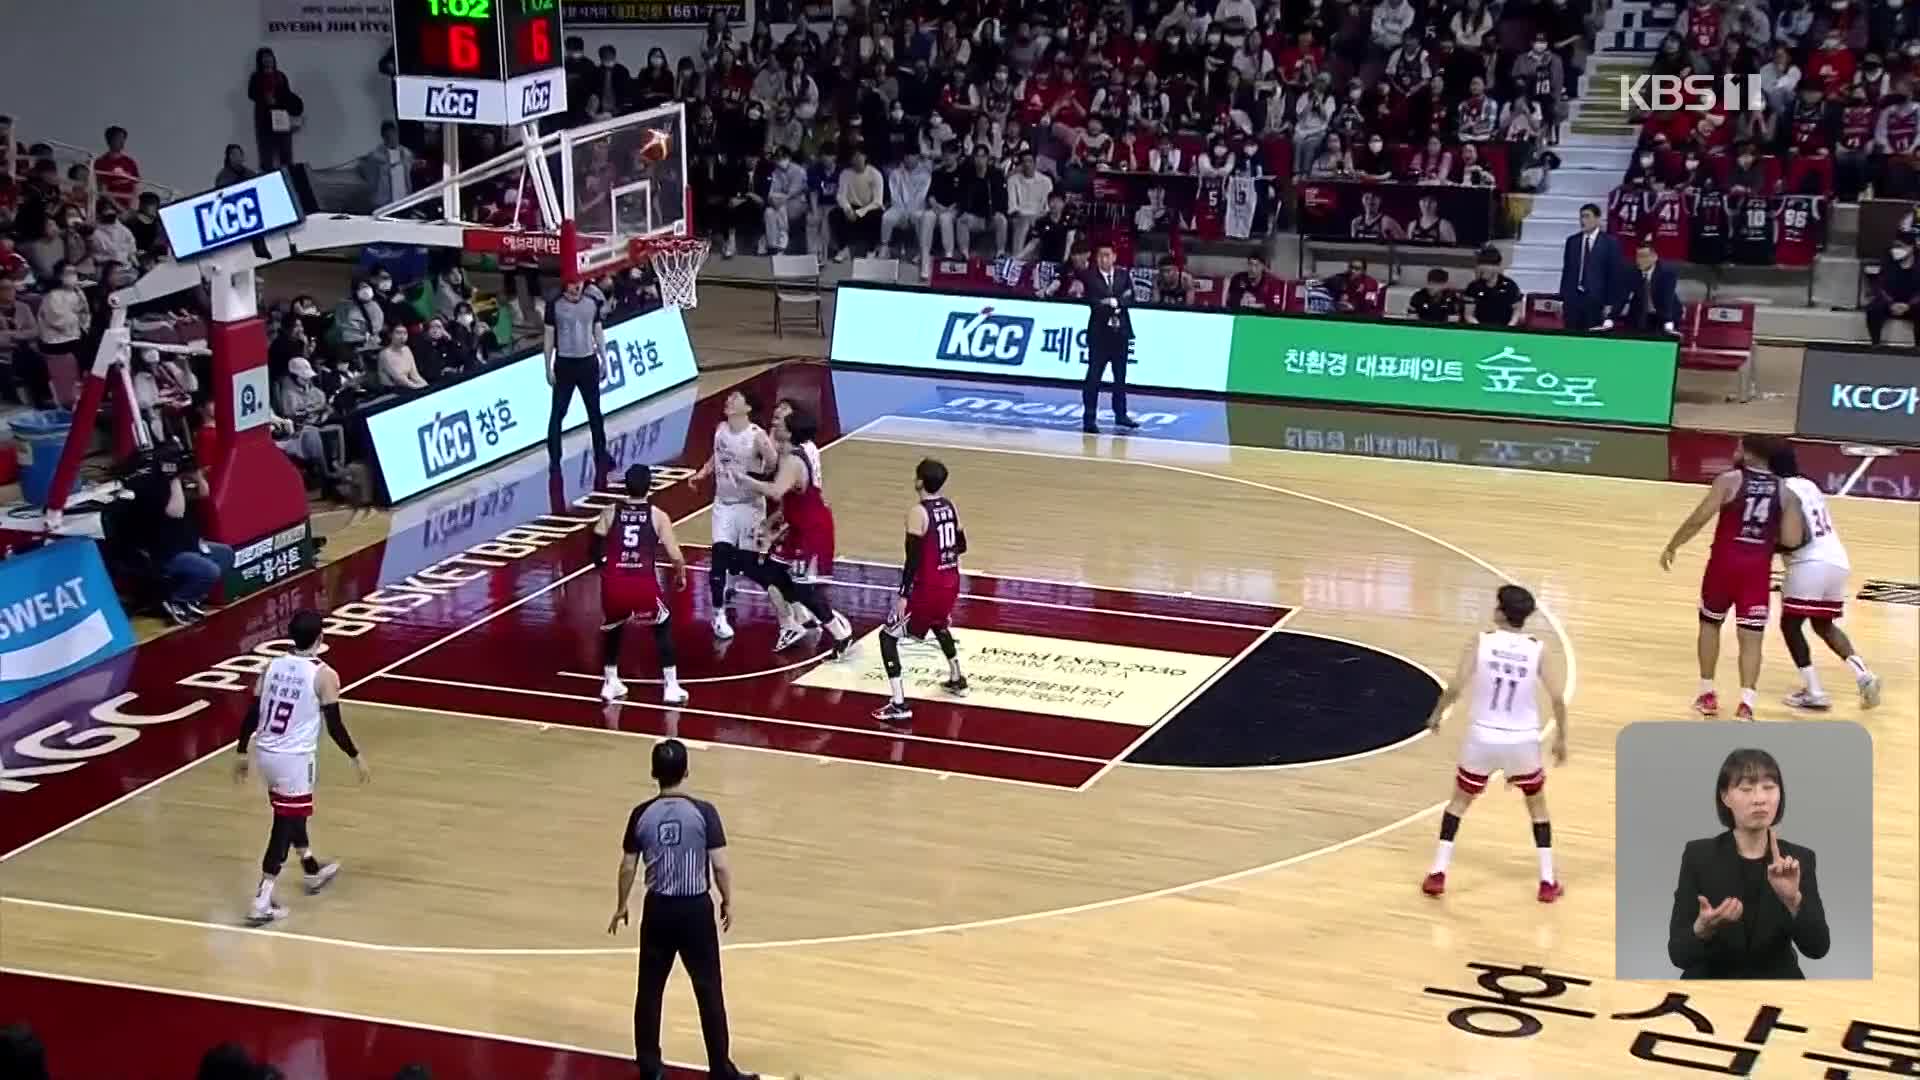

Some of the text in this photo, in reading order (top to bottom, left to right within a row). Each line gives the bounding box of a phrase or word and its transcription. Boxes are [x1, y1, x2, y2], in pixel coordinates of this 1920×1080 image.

[449, 24, 480, 70] 6
[531, 18, 550, 62] 6
[430, 86, 474, 115] KCC
[524, 84, 550, 113] KCC
[201, 194, 259, 242] KCC
[1619, 202, 1639, 222] 41
[1658, 203, 1680, 221] 41
[946, 311, 1026, 362] KCC
[625, 339, 664, 376] 창호
[1283, 346, 1606, 407] 친환경 대표페인트 숲으로
[423, 399, 518, 474] KCC 창호
[1743, 496, 1771, 523] 14
[623, 524, 640, 548] 5
[937, 522, 956, 550] 10
[262, 547, 301, 582] 홍삼톤
[1489, 677, 1520, 713] 11
[263, 699, 295, 734] 19
